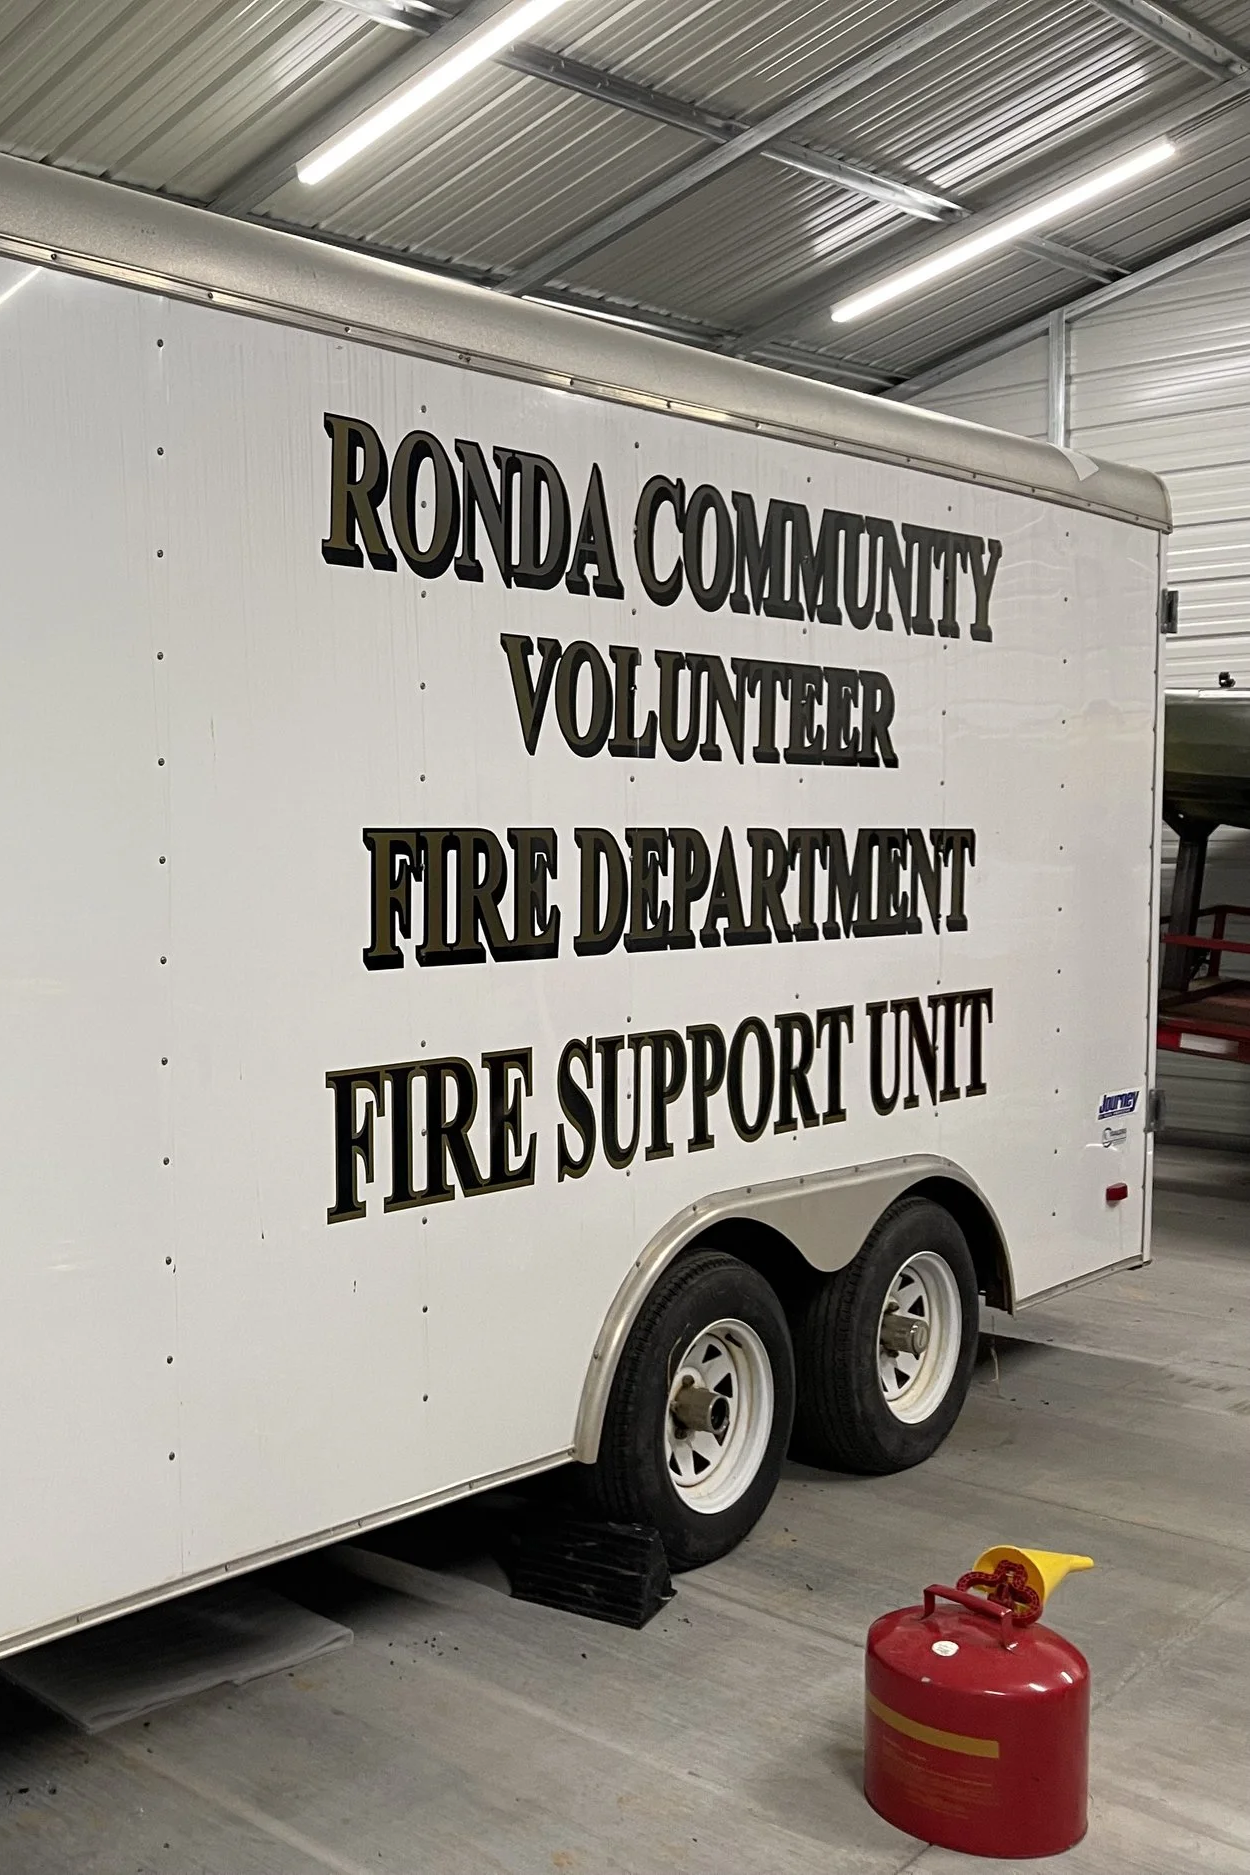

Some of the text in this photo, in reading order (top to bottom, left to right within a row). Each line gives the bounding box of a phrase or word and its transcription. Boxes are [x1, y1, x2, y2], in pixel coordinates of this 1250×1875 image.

[321, 412, 1002, 642] RONDA COMMUNITY
[500, 633, 899, 768] VOLUNTEER
[362, 826, 976, 971] FIRE DEPARTMENT
[325, 987, 994, 1225] FIRE SUPPORT UNIT
